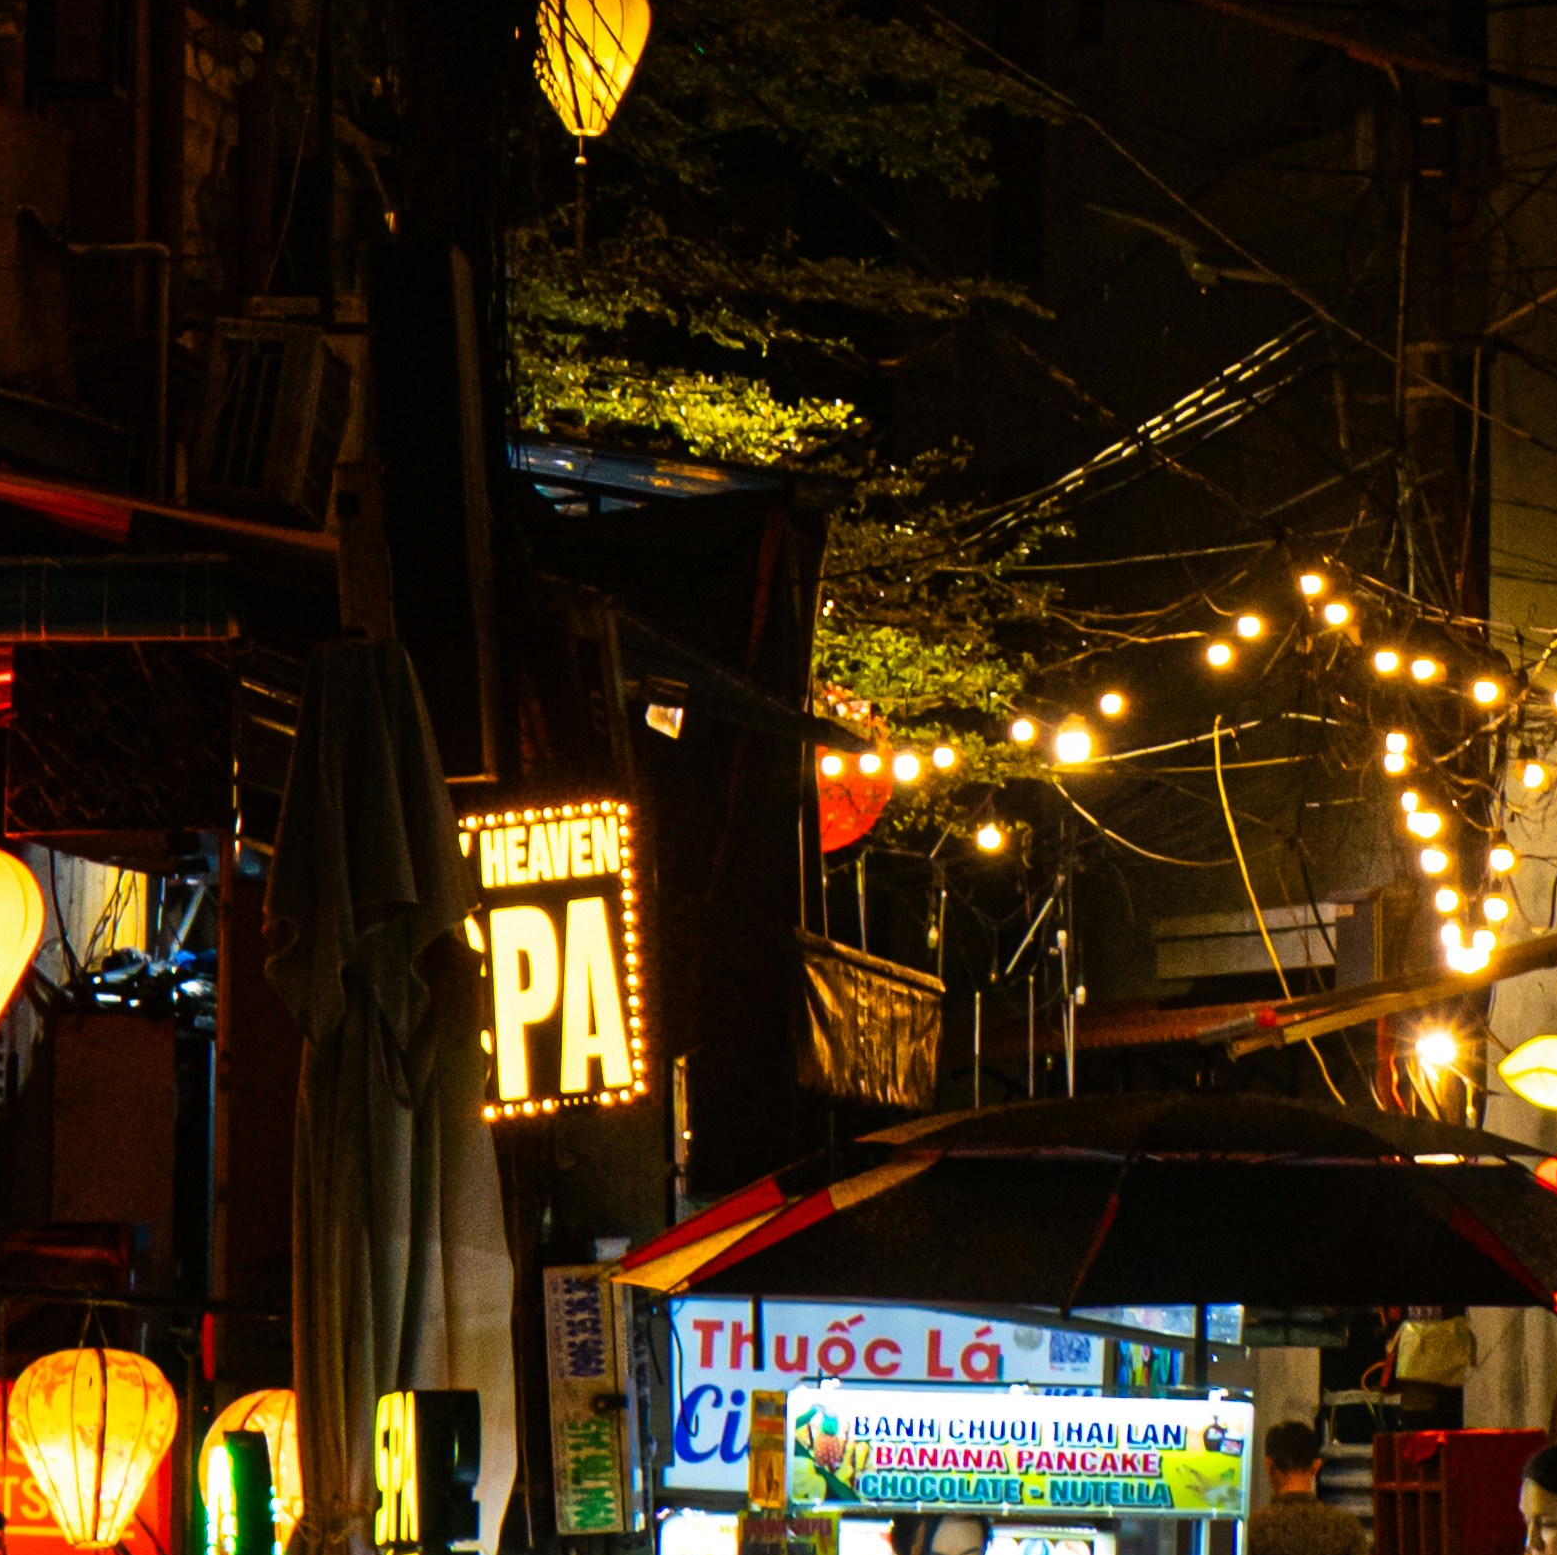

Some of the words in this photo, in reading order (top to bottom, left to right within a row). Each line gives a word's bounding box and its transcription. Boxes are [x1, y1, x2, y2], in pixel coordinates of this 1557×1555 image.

[479, 815, 621, 889] HEAVEN
[464, 896, 634, 1102] PA
[926, 1324, 1003, 1381] Lá
[1127, 1423, 1185, 1449] LAN
[875, 1447, 1006, 1471] BANANA
[1017, 1449, 1161, 1475] PANCAKE
[861, 1474, 1021, 1504] CHOCOLATE
[1050, 1480, 1172, 1507] NUTELLA
